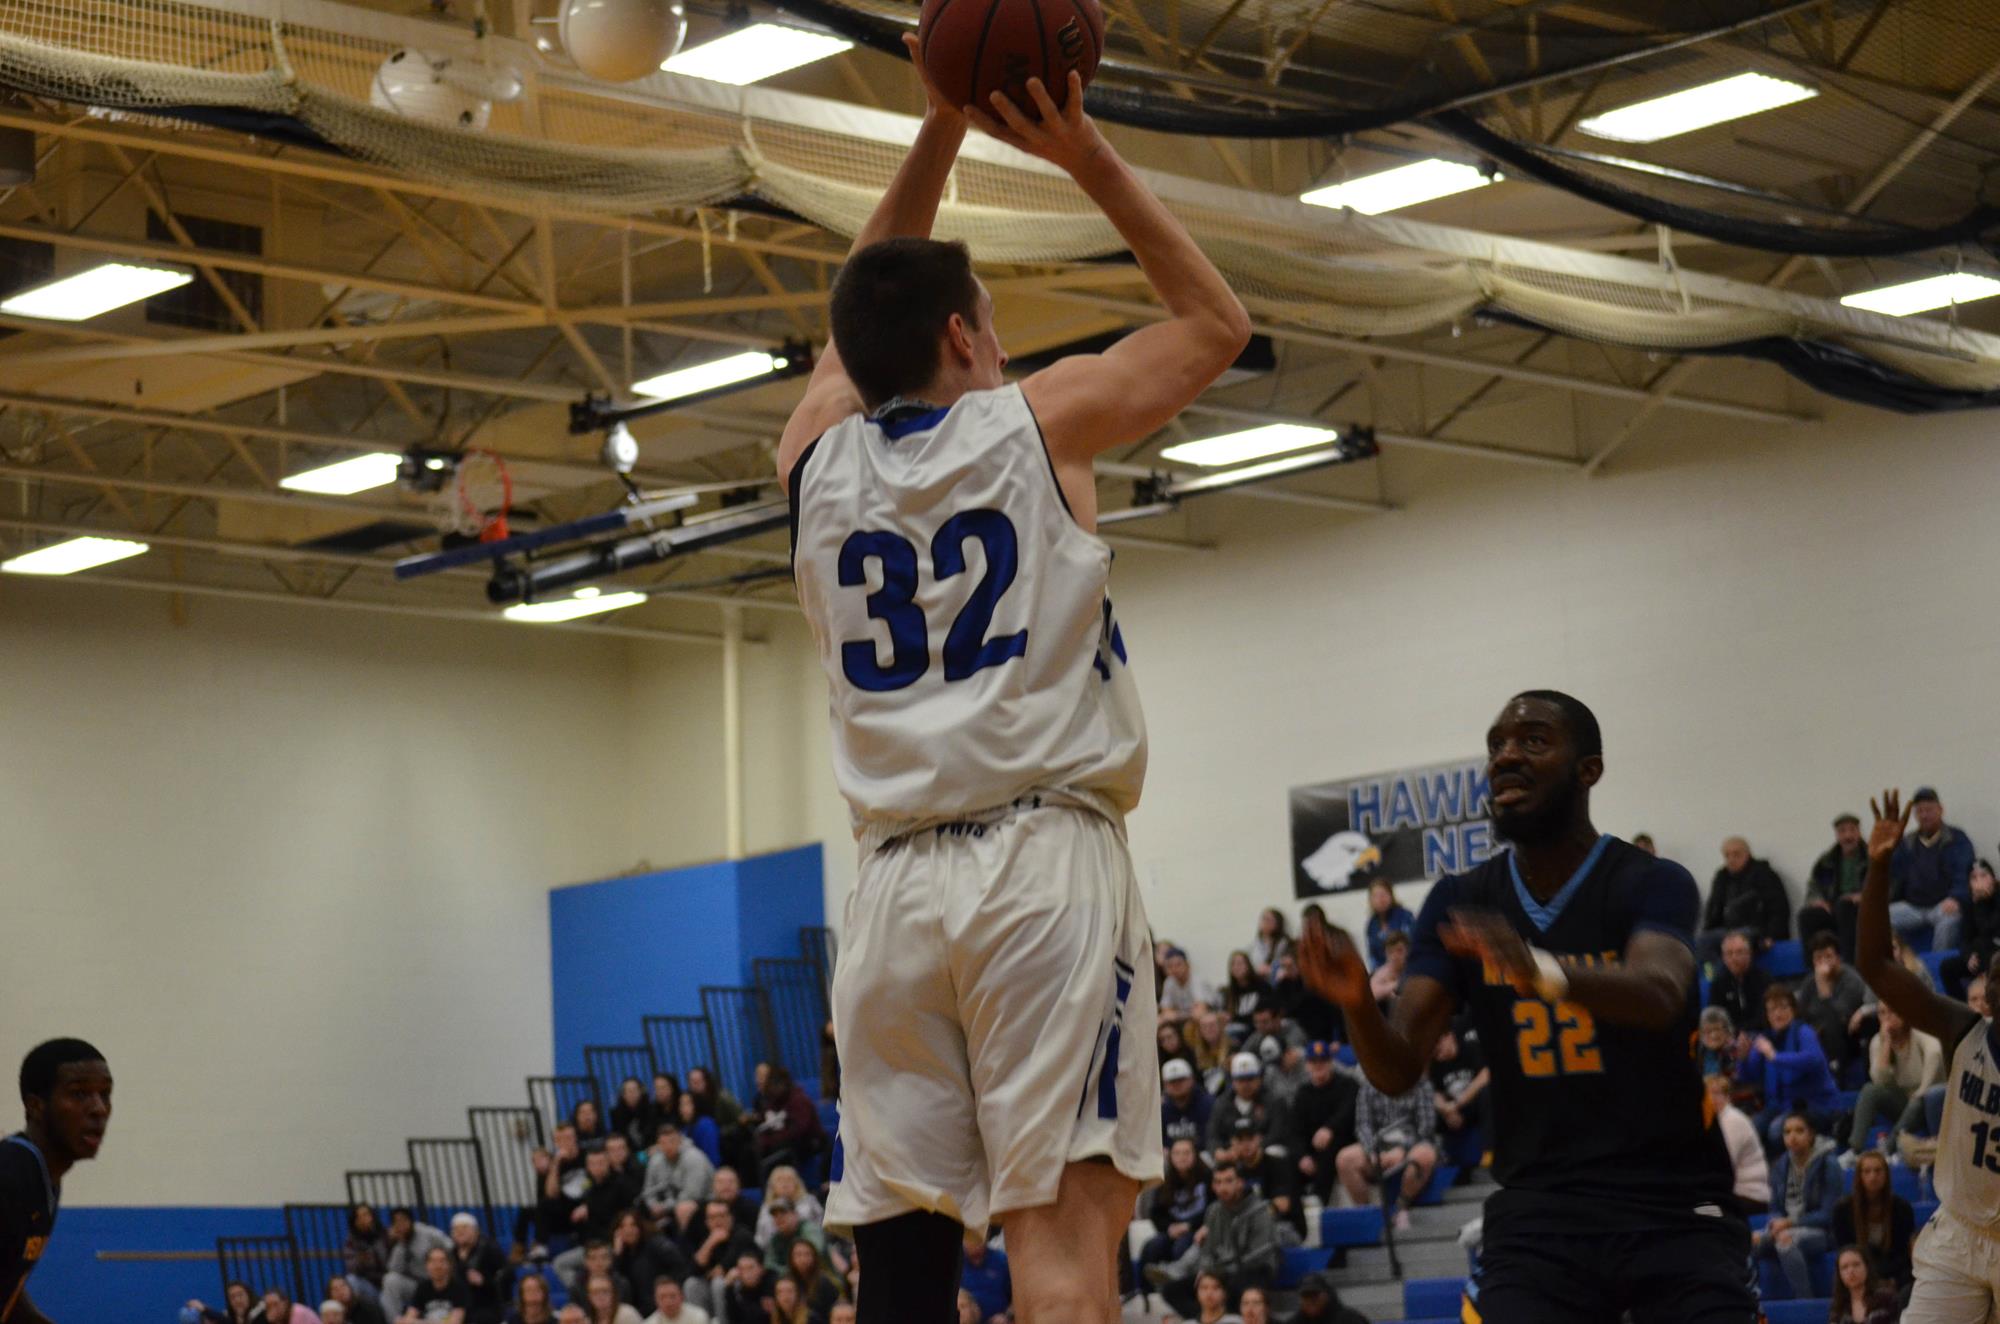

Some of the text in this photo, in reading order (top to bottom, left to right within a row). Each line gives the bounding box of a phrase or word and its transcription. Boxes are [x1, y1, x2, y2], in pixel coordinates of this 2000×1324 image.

[837, 508, 1028, 692] 32
[1511, 999, 1604, 1078] 22
[1970, 1120, 2000, 1175] 13
